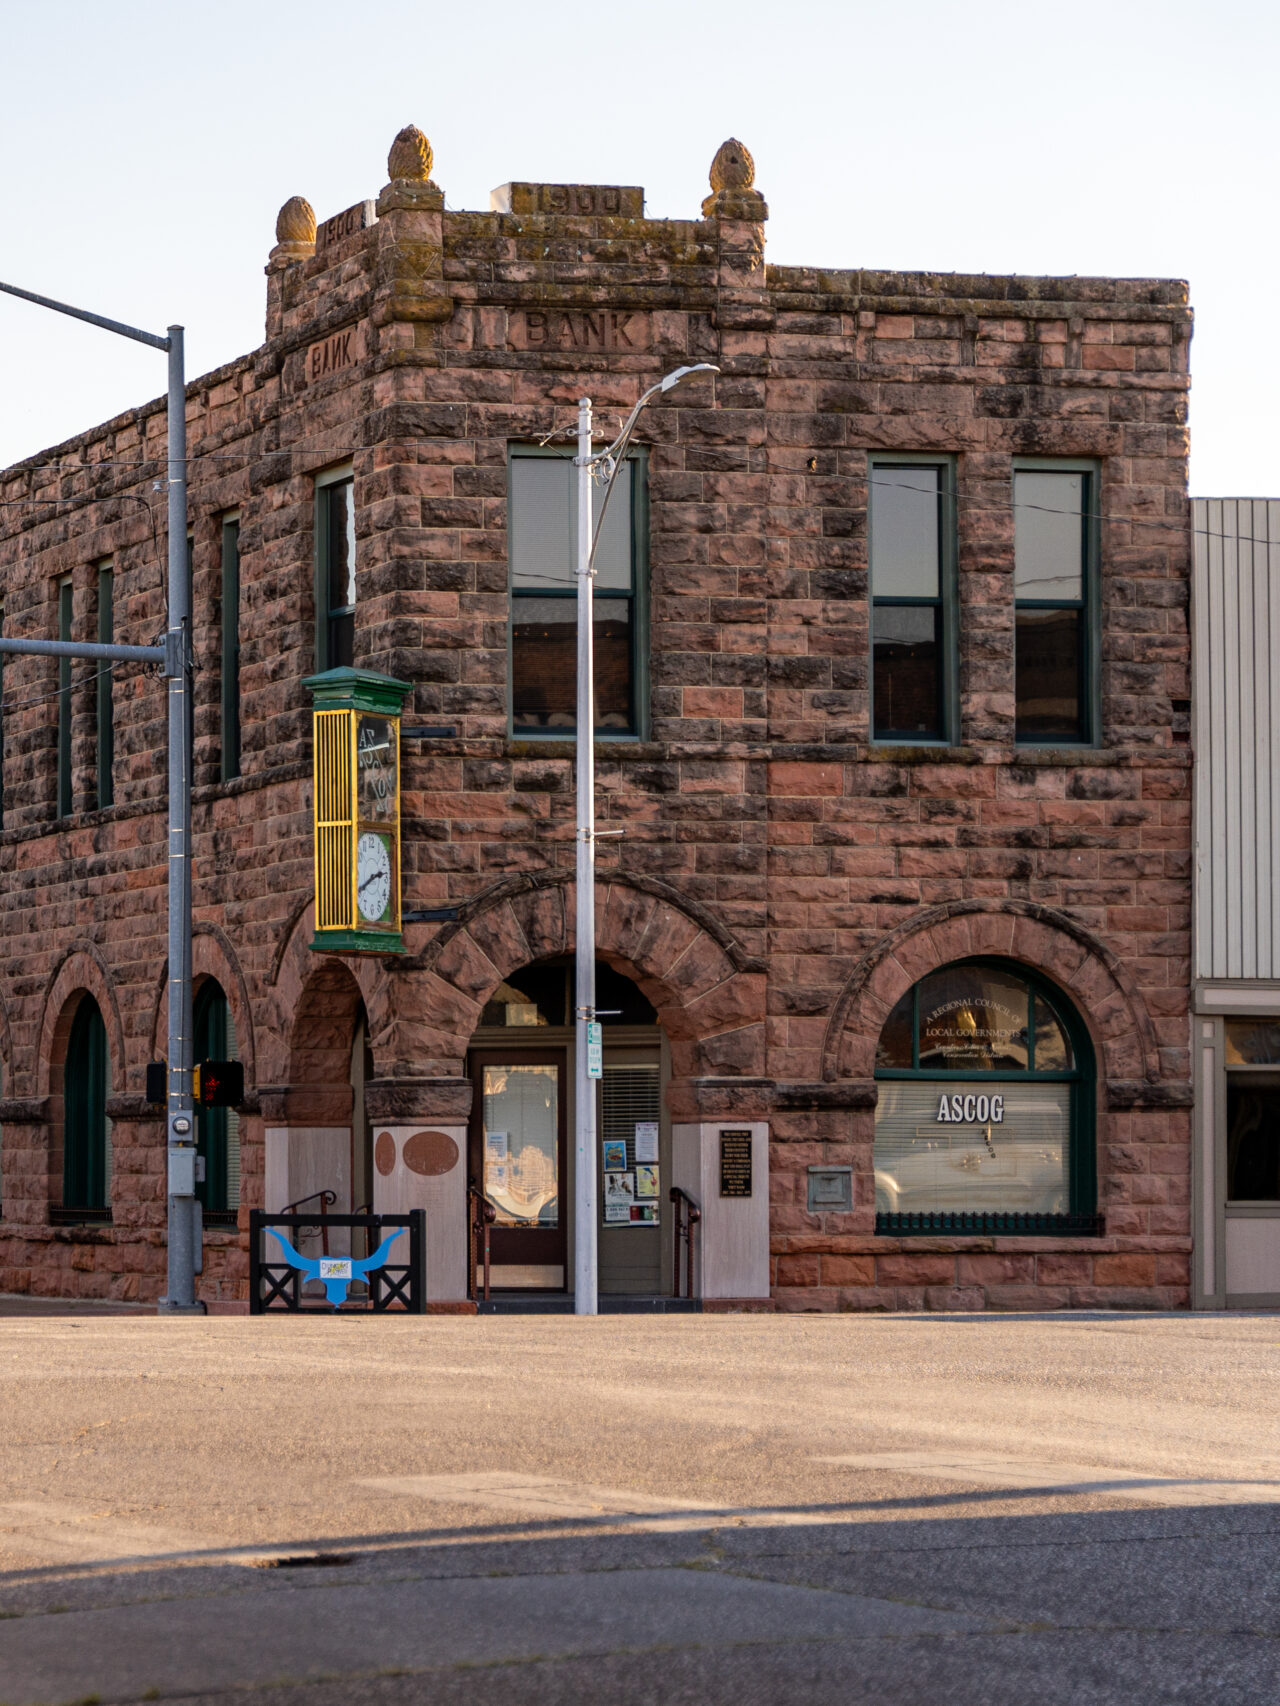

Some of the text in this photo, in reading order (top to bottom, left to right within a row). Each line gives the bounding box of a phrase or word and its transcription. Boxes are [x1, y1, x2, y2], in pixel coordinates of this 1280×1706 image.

[526, 311, 634, 347] BANK
[312, 332, 351, 379] BANK
[932, 998, 974, 1018] REGIONAL
[974, 998, 1011, 1017] COUNCIL
[926, 1028, 1021, 1038] LOCAL GOVERNMENTS
[937, 1094, 1004, 1123] ASCOG
